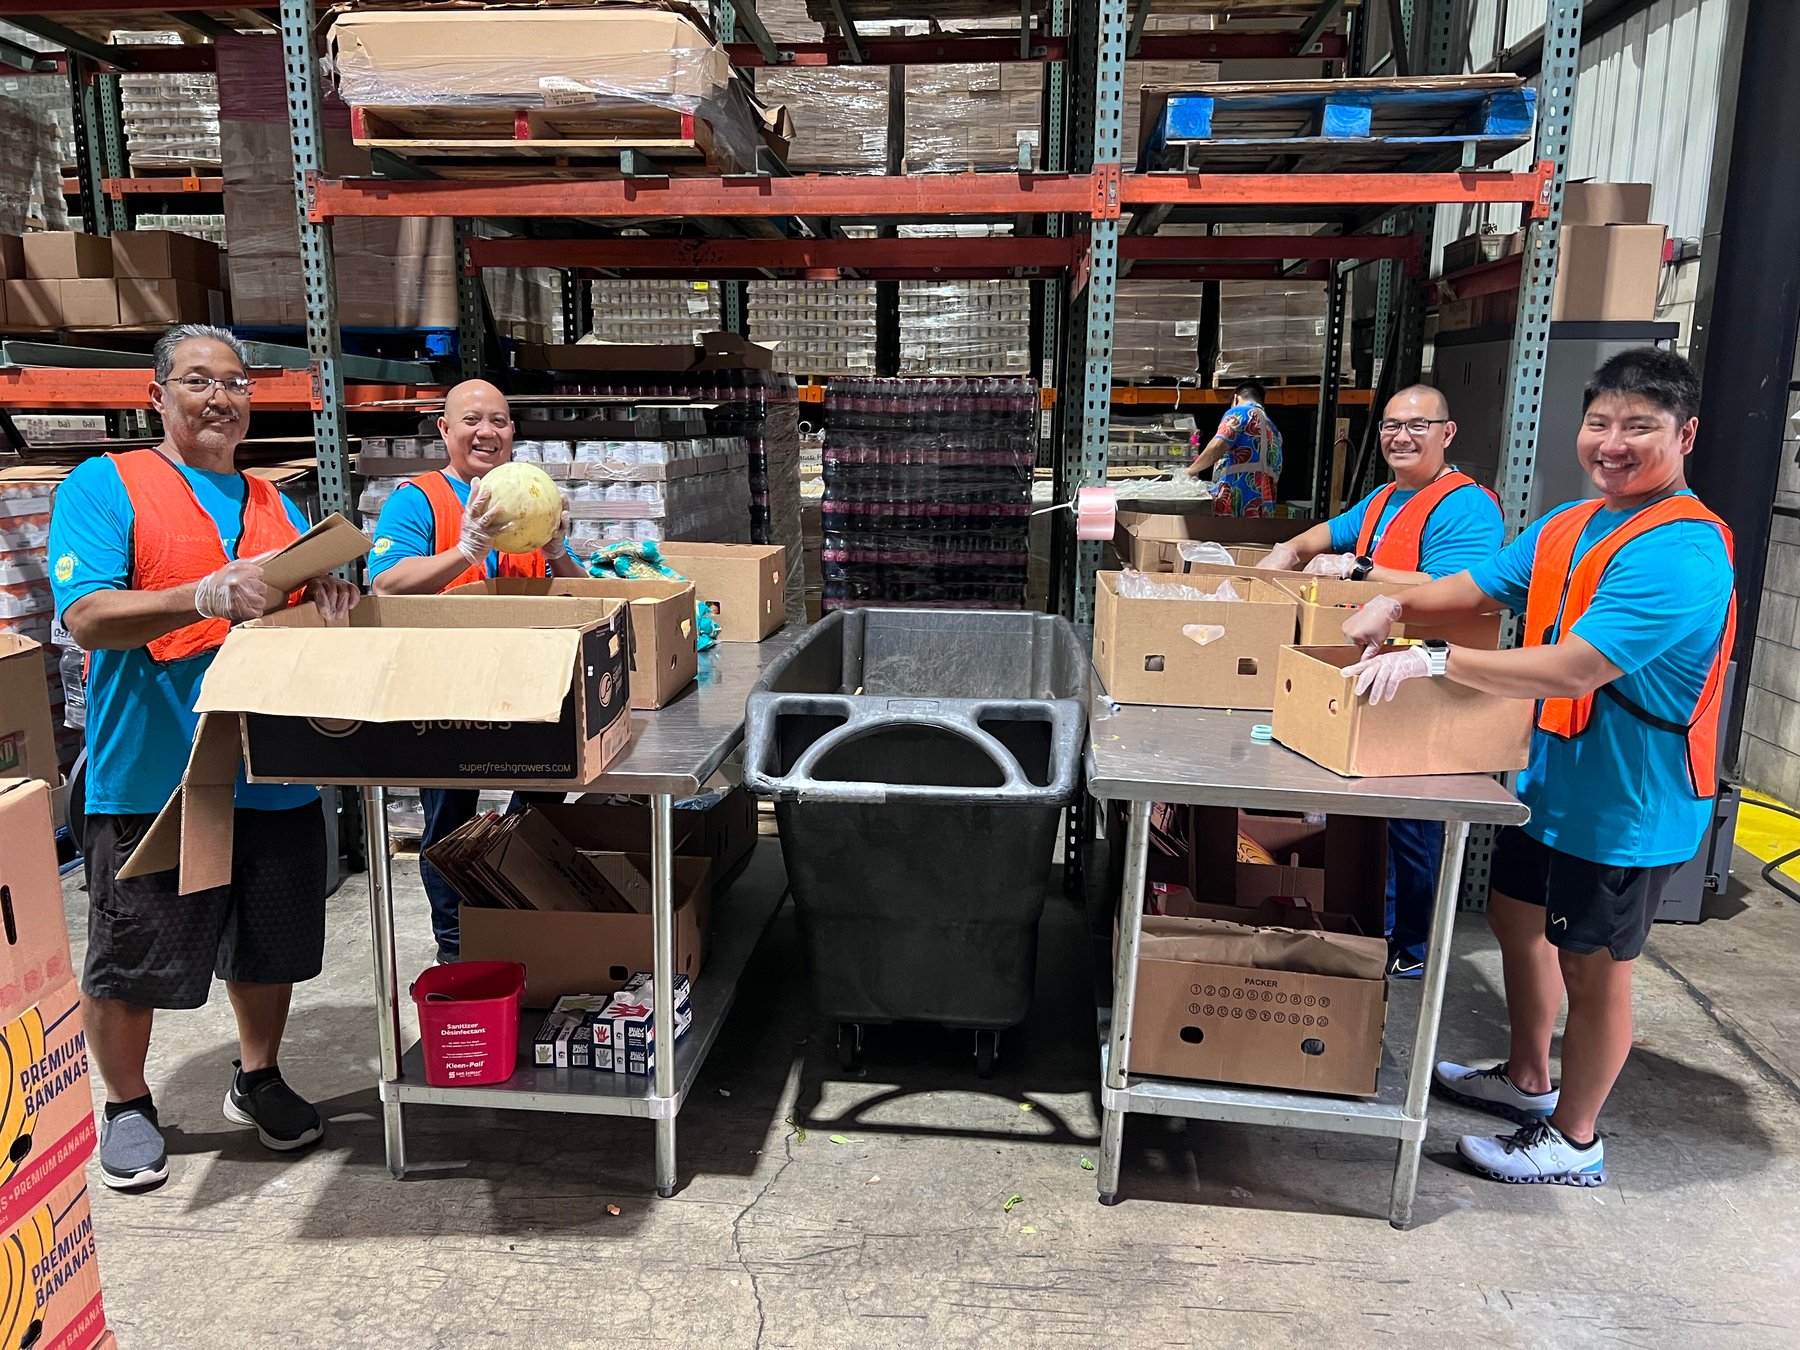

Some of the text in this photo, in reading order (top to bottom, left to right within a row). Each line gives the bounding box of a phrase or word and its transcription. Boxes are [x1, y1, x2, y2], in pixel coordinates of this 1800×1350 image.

[1244, 978, 1278, 988] PACKER
[20, 1030, 86, 1092] PREMIUM
[24, 1054, 89, 1118] BANANAS
[13, 1122, 94, 1200] PREMIUM BANANAS
[31, 1213, 92, 1285] PREMIUM
[35, 1236, 96, 1309] BANANAS
[66, 1300, 104, 1346] BANANAS
